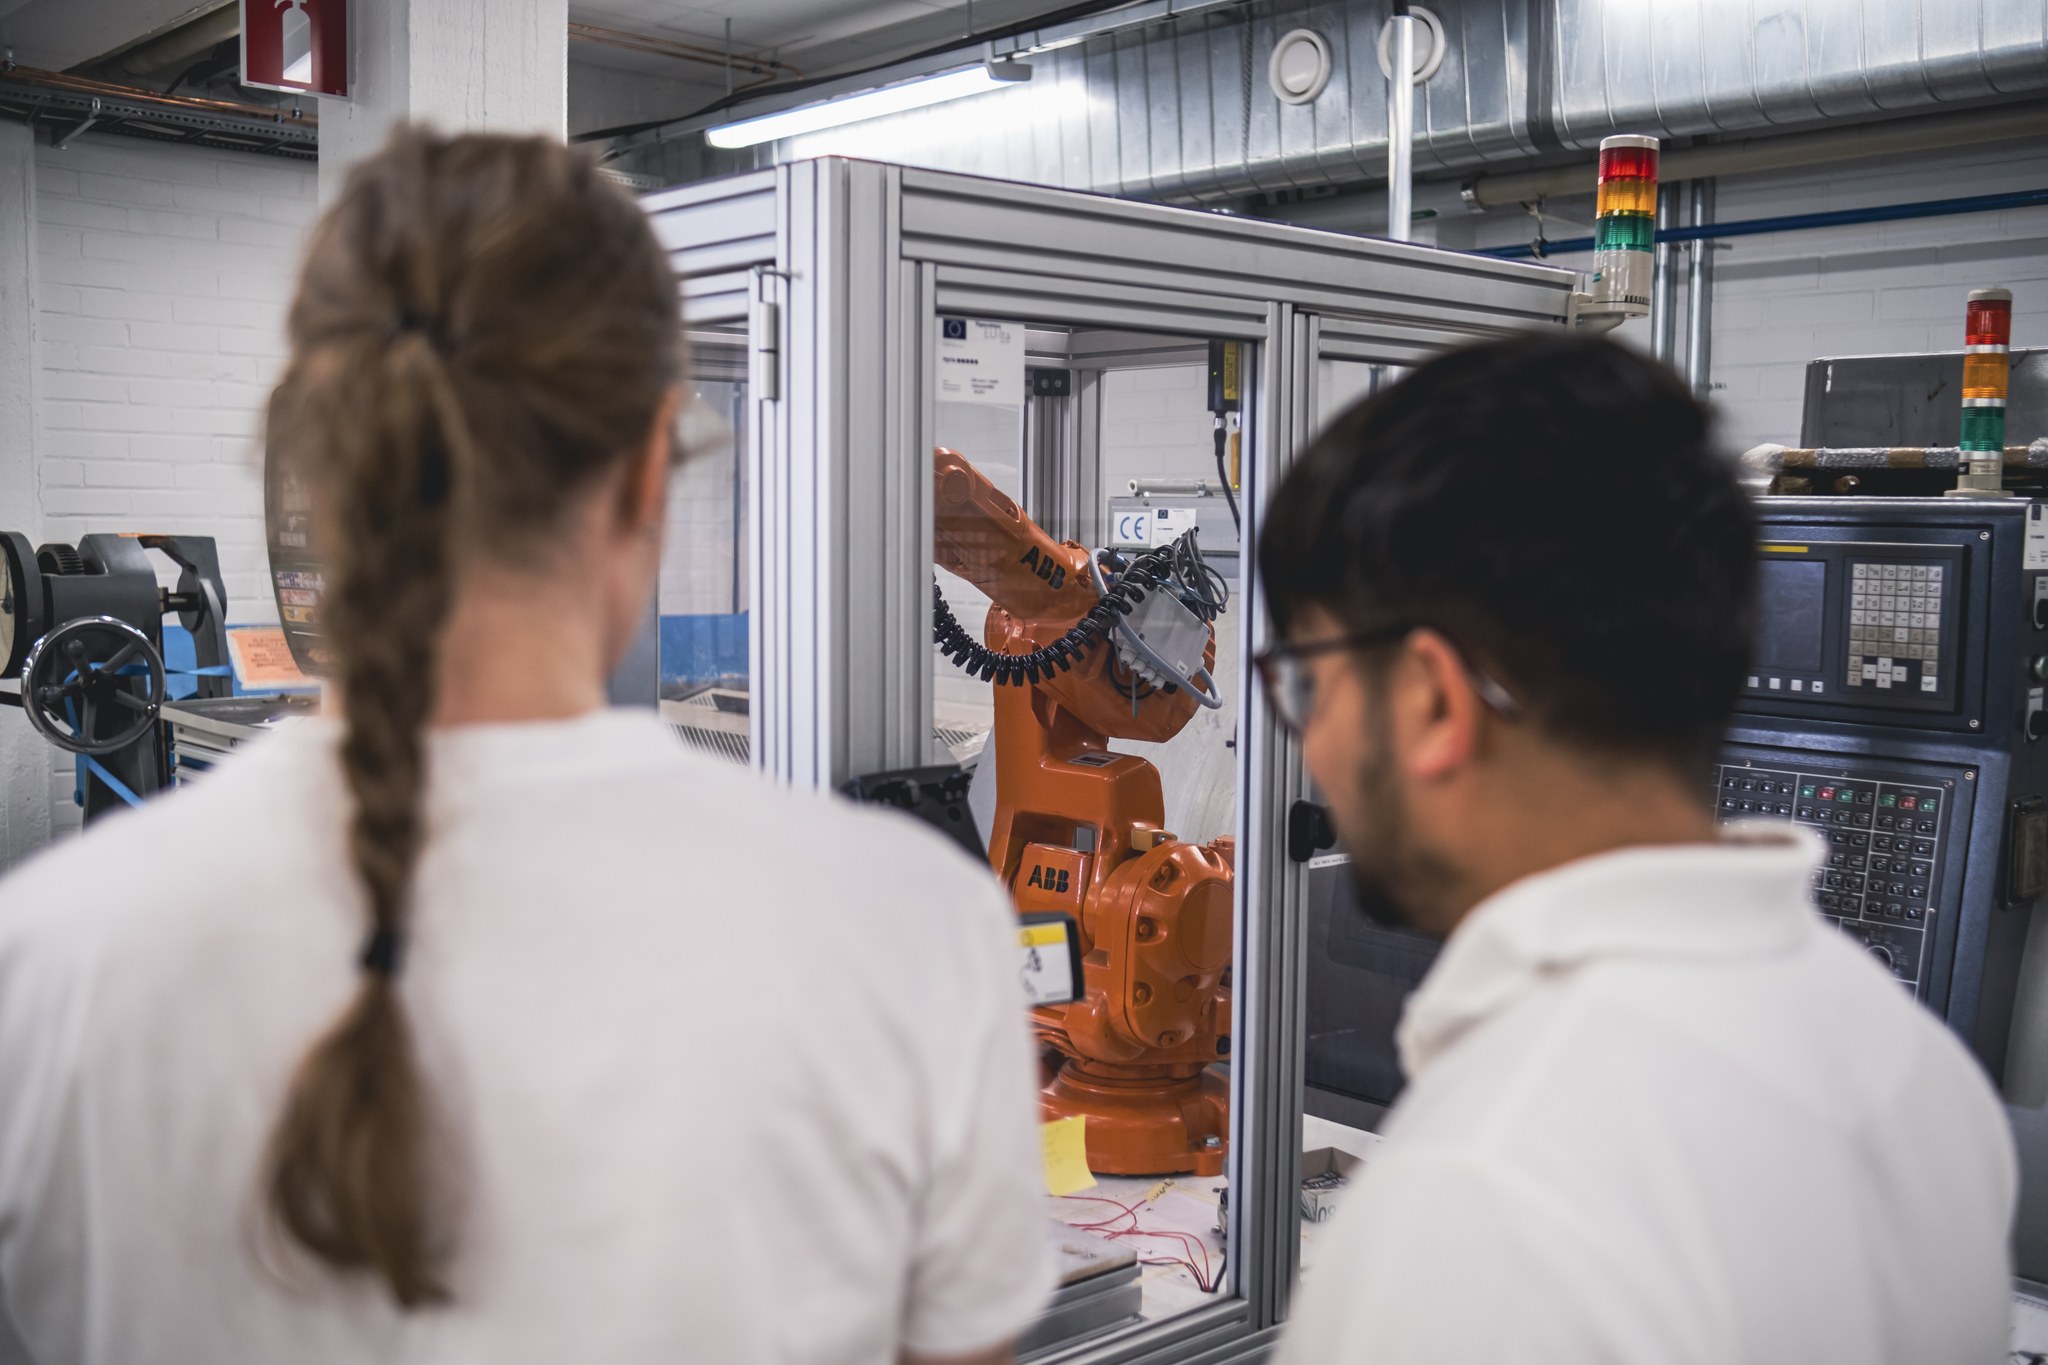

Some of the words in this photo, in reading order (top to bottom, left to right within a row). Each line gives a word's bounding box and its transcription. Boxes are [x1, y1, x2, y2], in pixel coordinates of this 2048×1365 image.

[1120, 516, 1144, 540] CE
[1020, 544, 1066, 590] ABB
[1027, 864, 1069, 893] ABB
